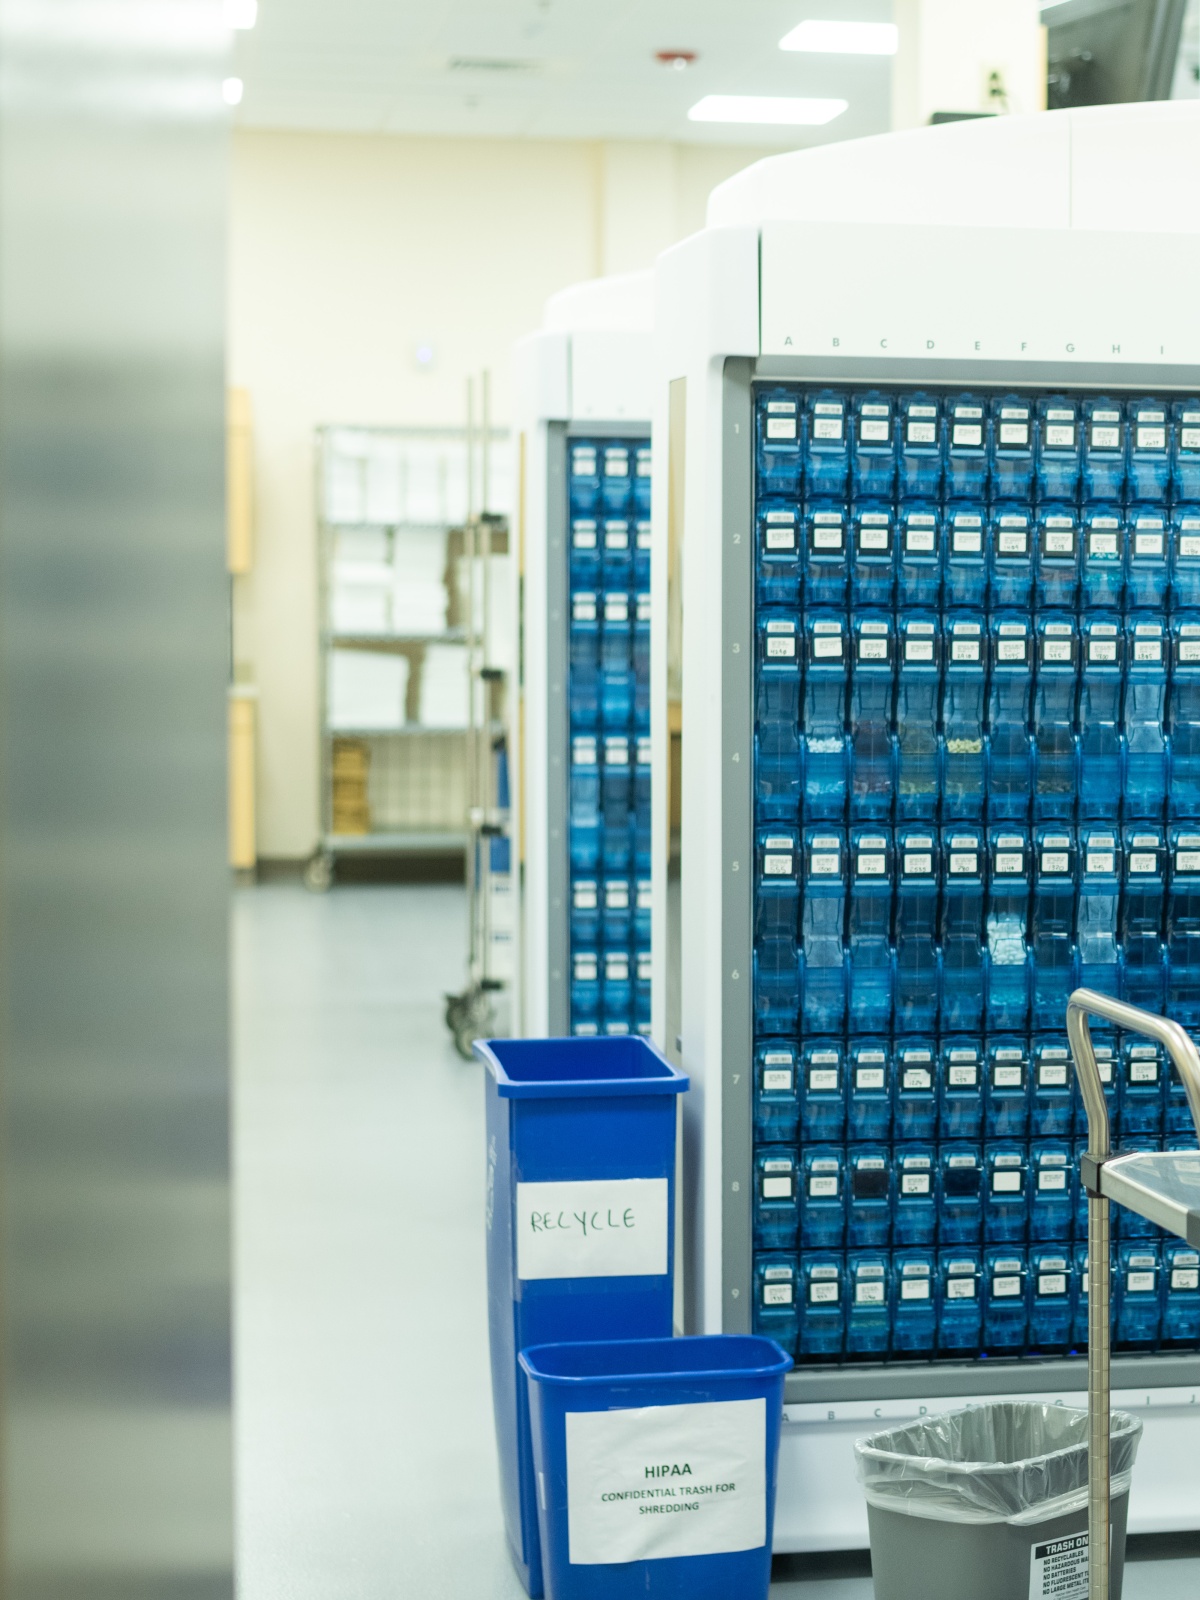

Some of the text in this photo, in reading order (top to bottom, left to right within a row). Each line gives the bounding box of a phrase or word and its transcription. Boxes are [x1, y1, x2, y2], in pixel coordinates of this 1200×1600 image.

[785, 337, 792, 345] A
[833, 338, 839, 346] B
[880, 339, 887, 348] C
[927, 340, 934, 349] D
[975, 342, 980, 350] E
[1022, 343, 1026, 351] F
[1066, 344, 1075, 352] G
[1113, 345, 1120, 353] H
[1161, 346, 1163, 354] I
[735, 424, 739, 433] 1
[733, 534, 740, 544] 2
[733, 643, 740, 653] 3
[732, 753, 739, 762] 4
[732, 861, 739, 871] 5
[732, 970, 739, 979] 6
[733, 1074, 740, 1084] 7
[732, 1182, 739, 1191] 8
[531, 1208, 636, 1236] RECYCLE
[732, 1289, 739, 1298] 9
[828, 1411, 835, 1420] B
[874, 1408, 881, 1417] C
[920, 1407, 927, 1415] D
[1190, 1395, 1195, 1403] J
[645, 1463, 692, 1478] HIPAA
[601, 1483, 736, 1502] CONFIDENTIAL TRASH FOR
[639, 1502, 699, 1514] SHREDDING
[1046, 1540, 1074, 1554] TRASH
[1051, 1550, 1084, 1564] RECYCLABLES
[1051, 1558, 1080, 1571] HAZARDOUS
[1051, 1567, 1076, 1578] BATTERIES
[1051, 1572, 1083, 1586] FLUORESCENT
[1051, 1585, 1066, 1594] LARGE
[1067, 1580, 1082, 1590] METAL
